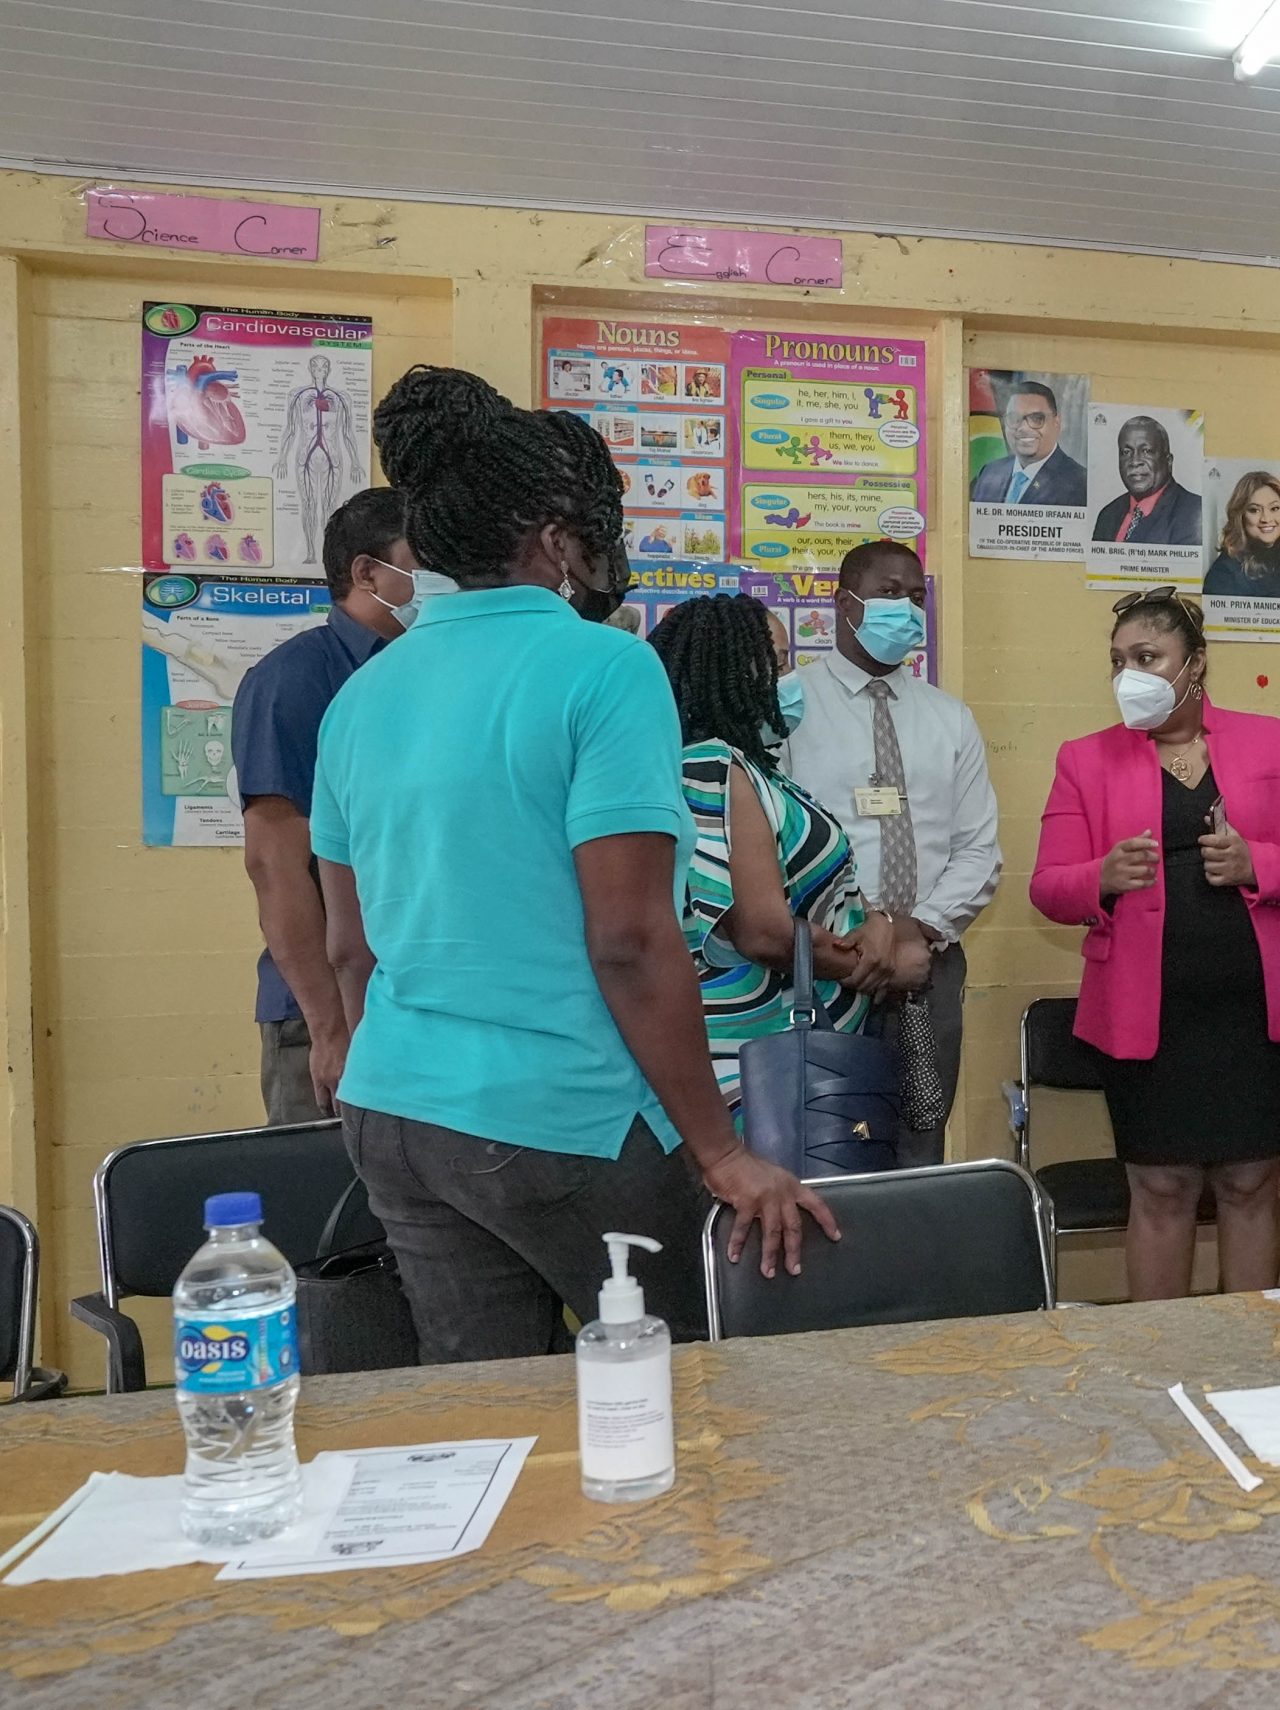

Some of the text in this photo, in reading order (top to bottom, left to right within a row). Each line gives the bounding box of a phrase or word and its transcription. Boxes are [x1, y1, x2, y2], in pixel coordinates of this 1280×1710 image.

[99, 192, 307, 256] Science Corner
[766, 246, 833, 285] Corner
[206, 316, 368, 340] Cardiovascular
[597, 321, 680, 347] Nouns
[319, 340, 362, 349] SYSTEM
[765, 334, 894, 365] Pronouns
[780, 360, 805, 368] pronoun
[747, 370, 787, 379] Personal
[798, 389, 811, 399] he,
[813, 390, 829, 400] her,
[832, 390, 850, 401] him,
[806, 401, 822, 409] me,
[824, 400, 841, 410] she,
[844, 402, 859, 411] you
[829, 430, 853, 441] them,
[855, 432, 875, 443] they,
[829, 443, 876, 453] us, we, you
[862, 480, 911, 489] Possessive
[807, 491, 883, 503] hers, his, its, mine,
[814, 503, 877, 514] my, your, yours
[976, 507, 1085, 520] H.E. DR. MOHAMED IRFAAN ALI
[998, 524, 1063, 539] PRESIDENT
[797, 535, 855, 546] our, ours, their,
[817, 549, 836, 557] your,
[1091, 547, 1108, 555] HON.
[1109, 547, 1127, 556] BRIG.
[1148, 549, 1168, 558] MARK
[1169, 550, 1199, 559] PHILLIPS
[1120, 565, 1170, 574] PRIME MINISTER
[628, 566, 716, 589] ectives
[791, 574, 840, 596] Ver
[213, 586, 310, 605] Skeletal
[1210, 600, 1228, 609] HON.
[1230, 600, 1252, 610] PRIYA
[1223, 616, 1251, 624] MINISTER
[1252, 617, 1260, 625] OF
